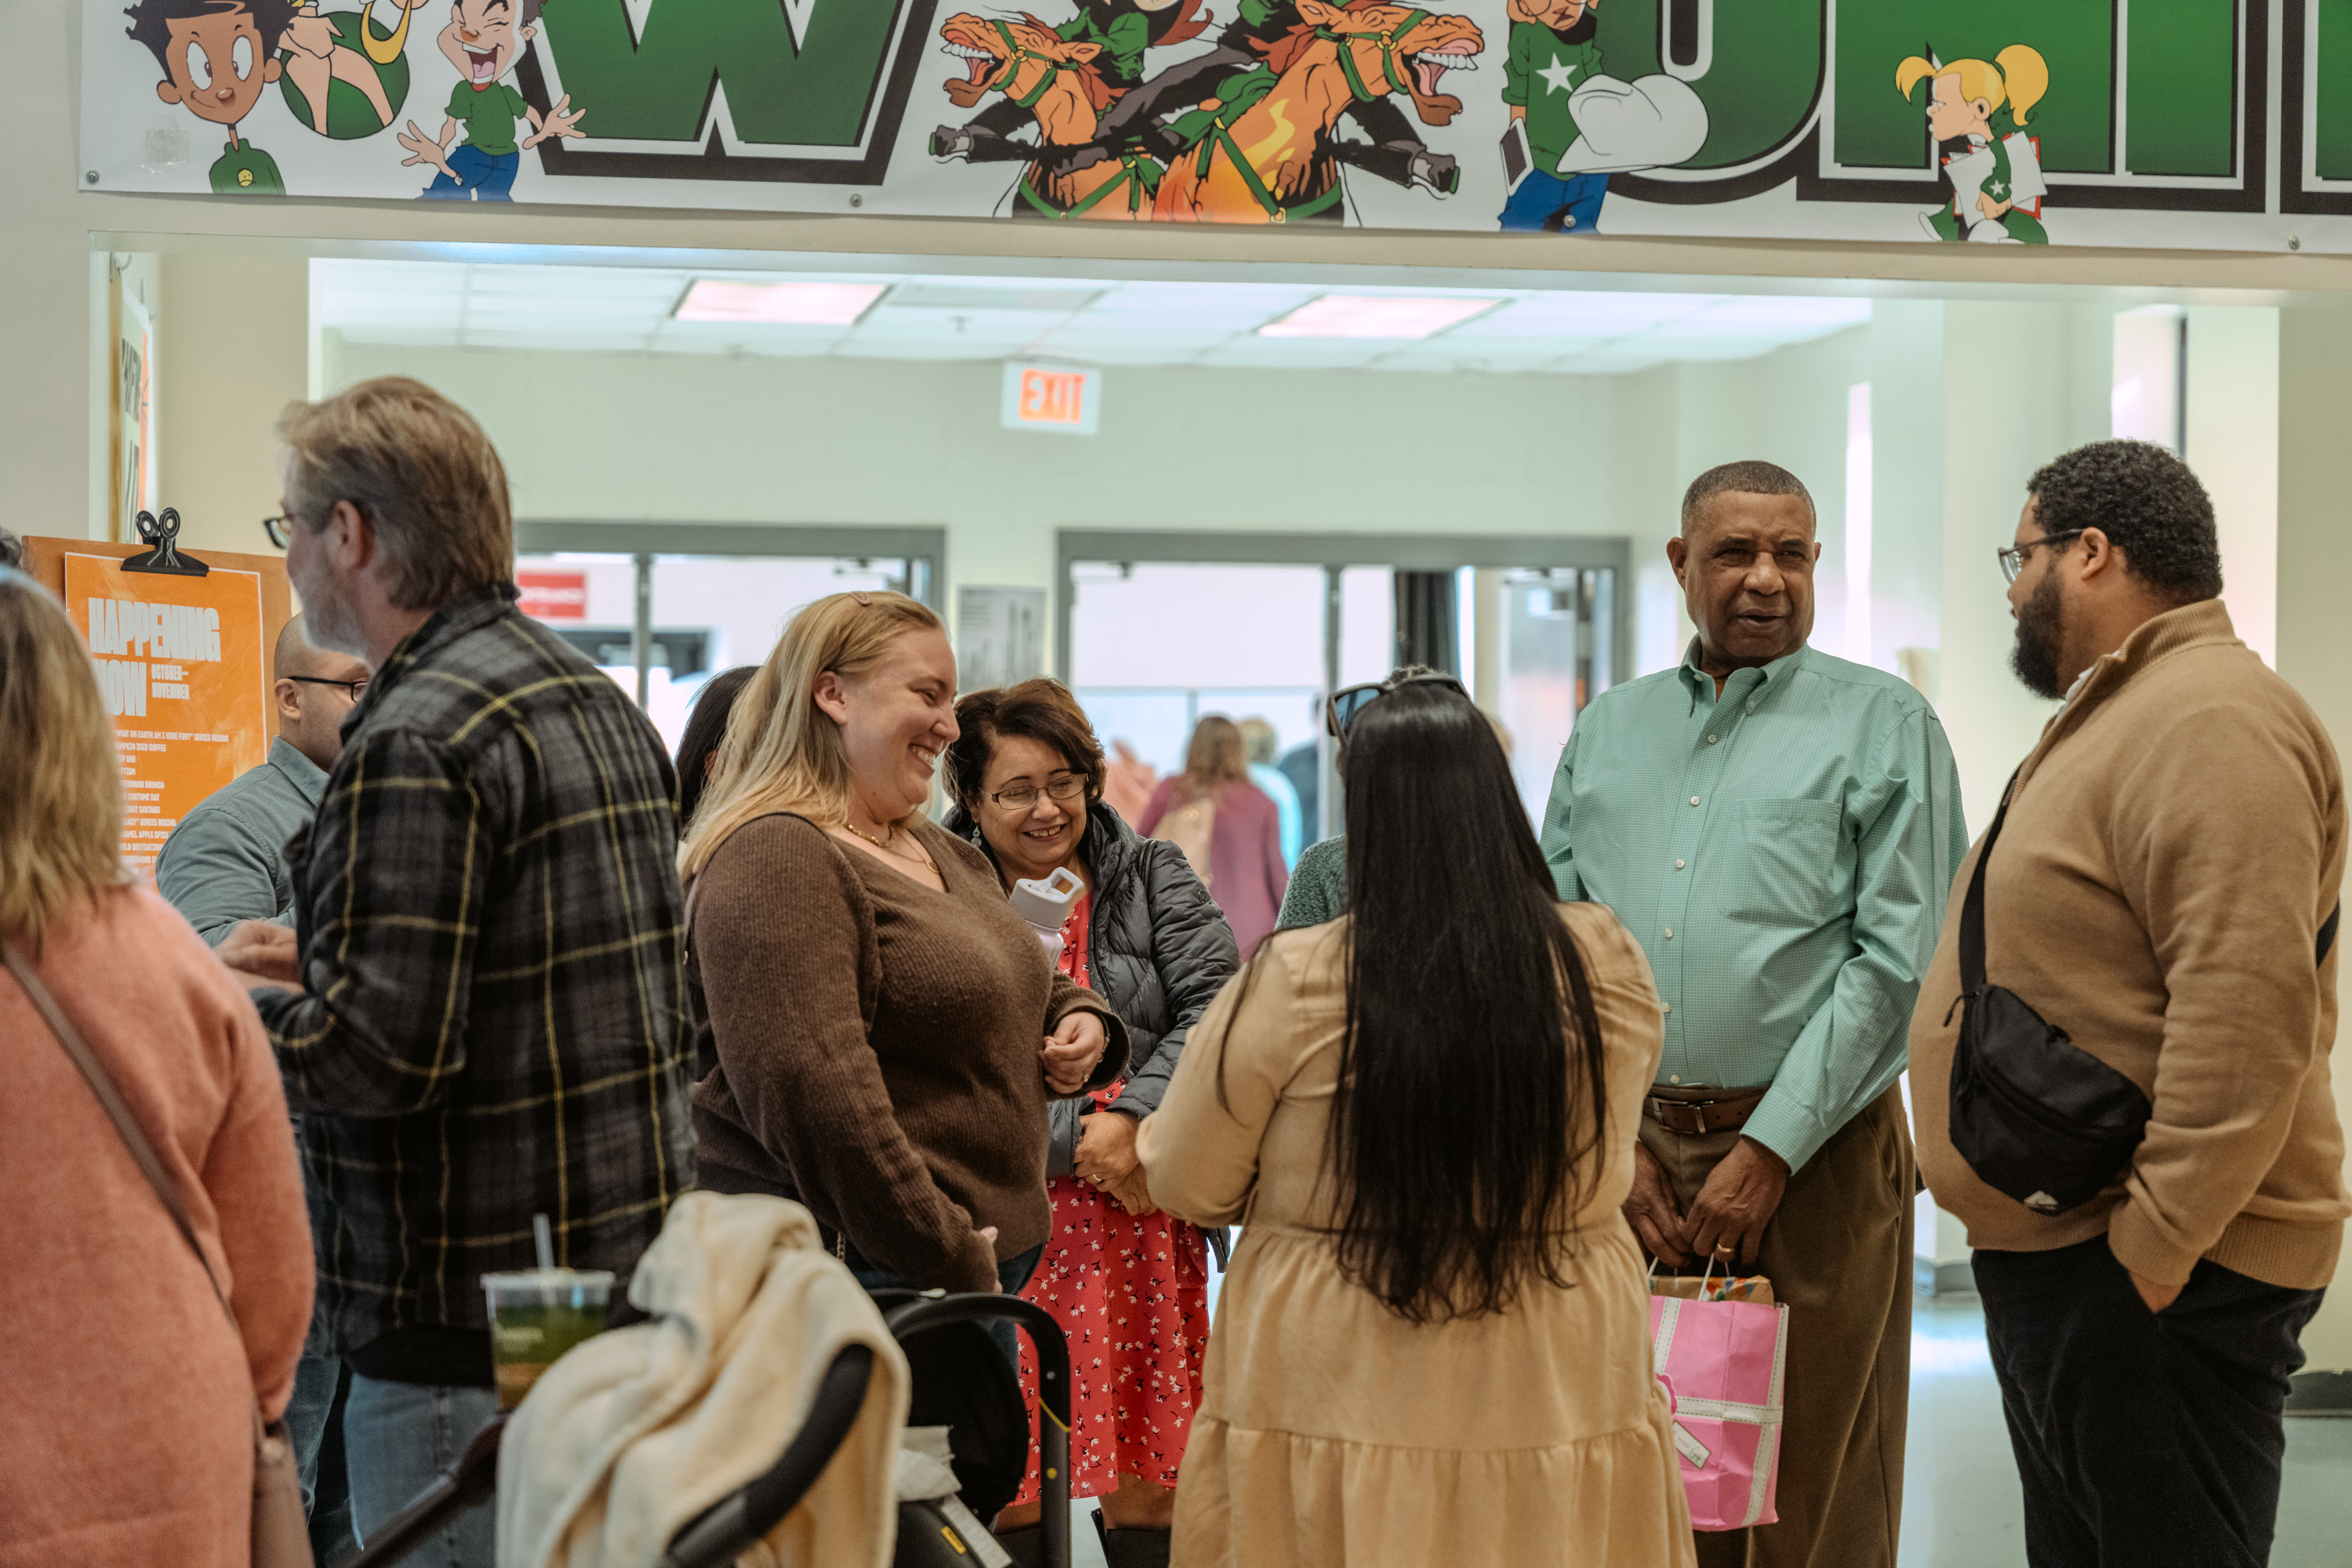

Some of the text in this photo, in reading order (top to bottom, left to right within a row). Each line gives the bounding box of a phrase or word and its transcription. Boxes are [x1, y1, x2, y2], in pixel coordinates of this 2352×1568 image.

[1019, 368, 1087, 424] EXIT
[89, 597, 221, 662] HAPPENING
[91, 658, 147, 717] NOW
[152, 682, 190, 700] NOVEMBER
[154, 731, 162, 739] AM
[166, 731, 178, 740] HERE
[194, 733, 211, 742] SERIES
[212, 734, 229, 742] BEGINS
[136, 742, 148, 751] ICED
[149, 743, 166, 752] COFFEE
[122, 780, 144, 789] TERHOOD
[128, 793, 150, 801] COSTUME
[139, 805, 160, 814] SAVINGS
[140, 818, 157, 826] SERIES
[139, 830, 154, 839] APPLE
